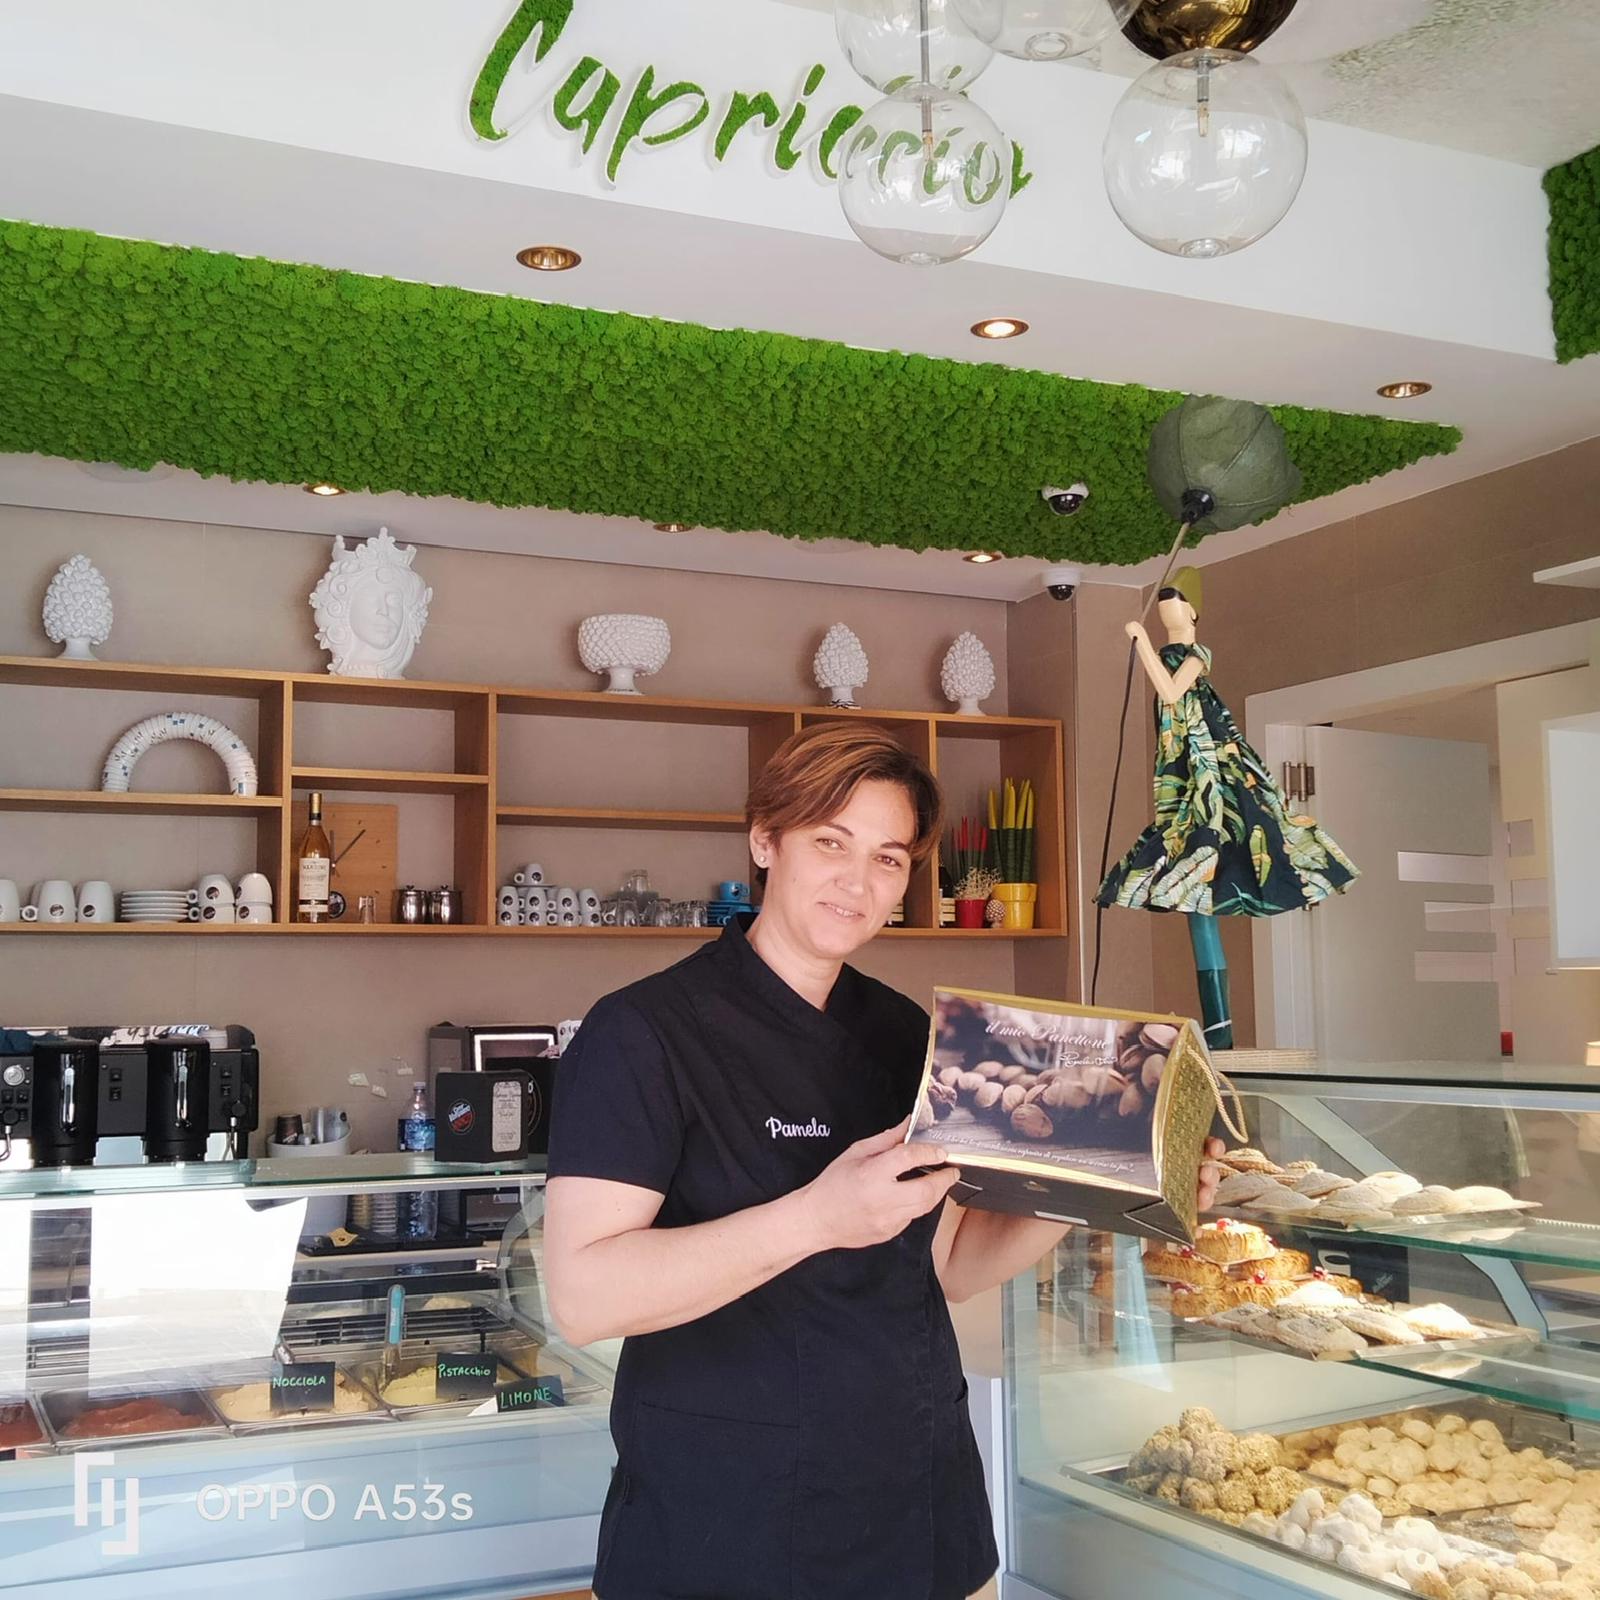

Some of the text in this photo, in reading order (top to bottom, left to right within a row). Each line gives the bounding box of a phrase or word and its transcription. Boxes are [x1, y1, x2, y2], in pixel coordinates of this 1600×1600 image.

[985, 1020, 1108, 1050] il mio Panettone
[765, 1116, 831, 1139] Pamela
[272, 1375, 327, 1389] NOCCIOLA
[500, 1386, 553, 1409] LIMONE
